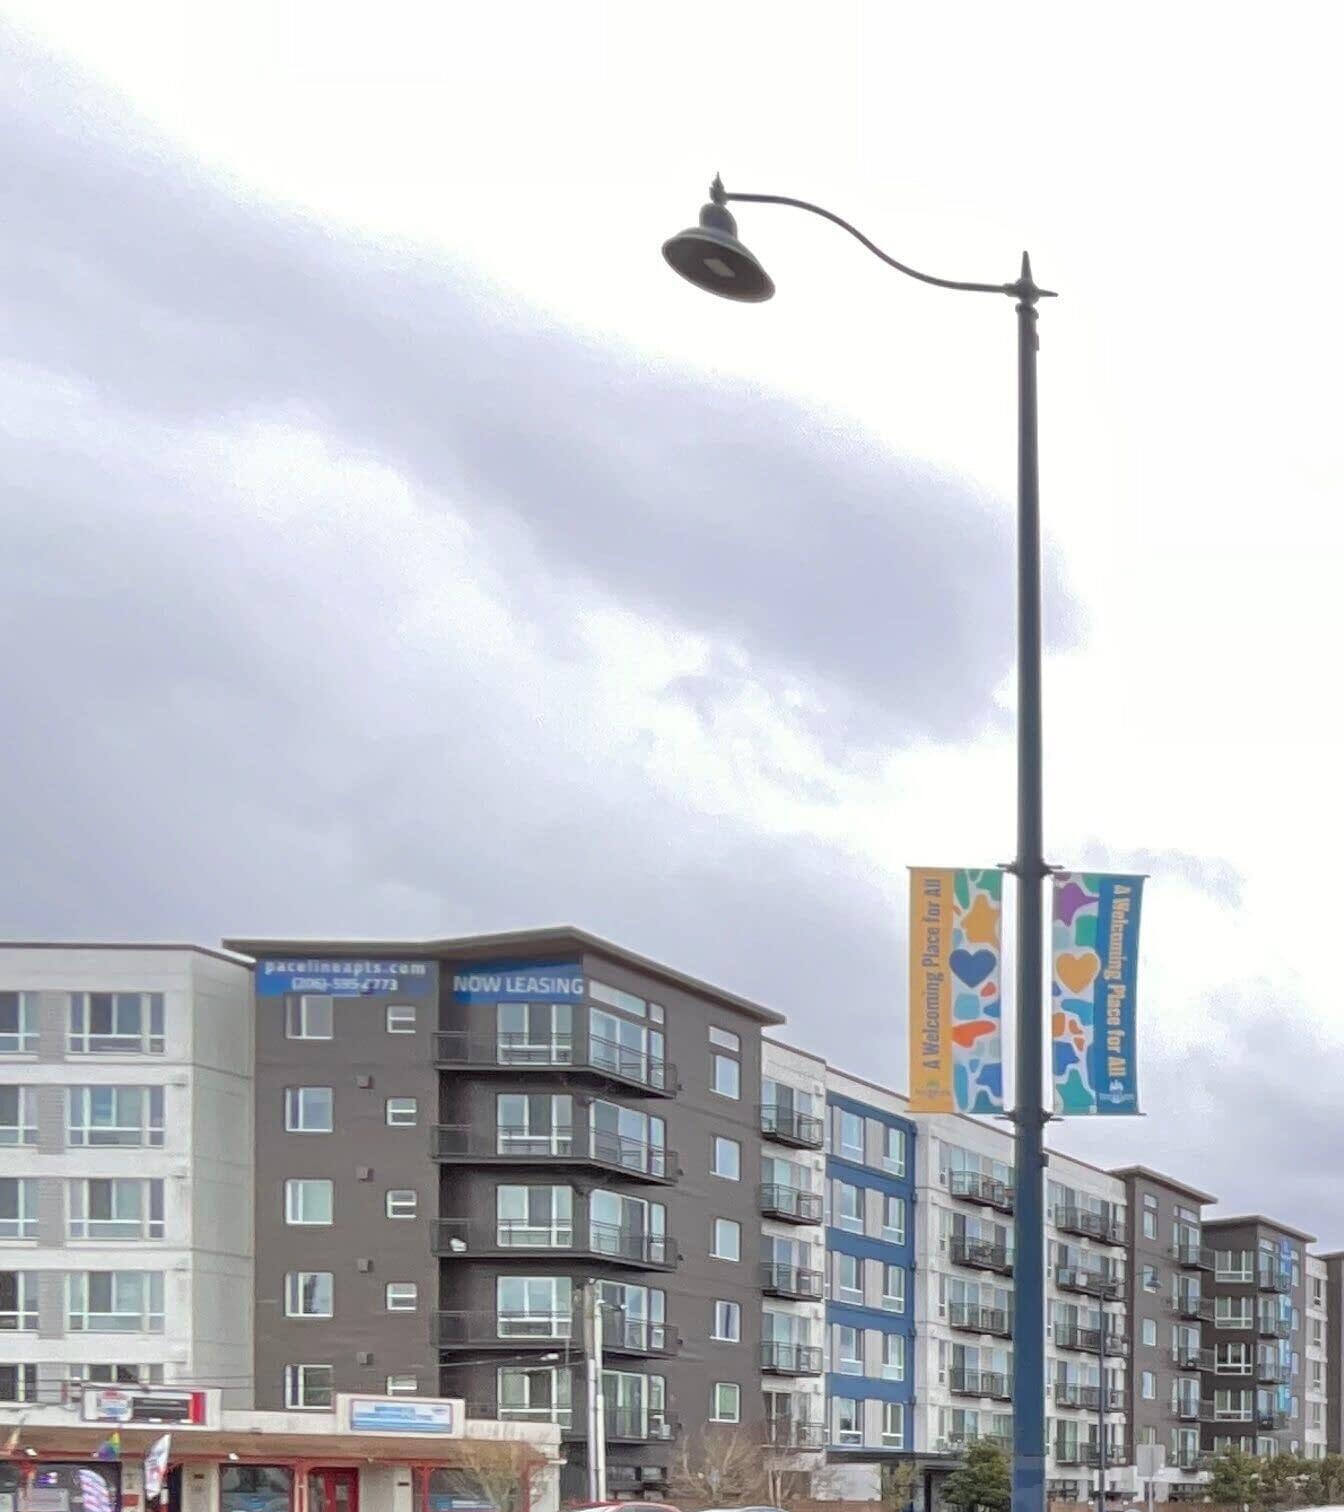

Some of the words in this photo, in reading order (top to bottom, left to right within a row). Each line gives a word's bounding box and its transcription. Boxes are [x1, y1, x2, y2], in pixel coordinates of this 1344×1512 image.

[923, 877, 942, 897] All
[1112, 884, 1131, 895] A
[921, 900, 941, 922] for
[921, 926, 940, 967] Place
[1103, 897, 1130, 980] Welcoming
[453, 974, 501, 993] NOW
[505, 975, 584, 995] LEASING
[921, 971, 945, 1056] Welcoming
[1106, 984, 1127, 1026] Place
[1106, 1029, 1126, 1054] for
[922, 1059, 941, 1070] A
[1107, 1055, 1127, 1078] All
